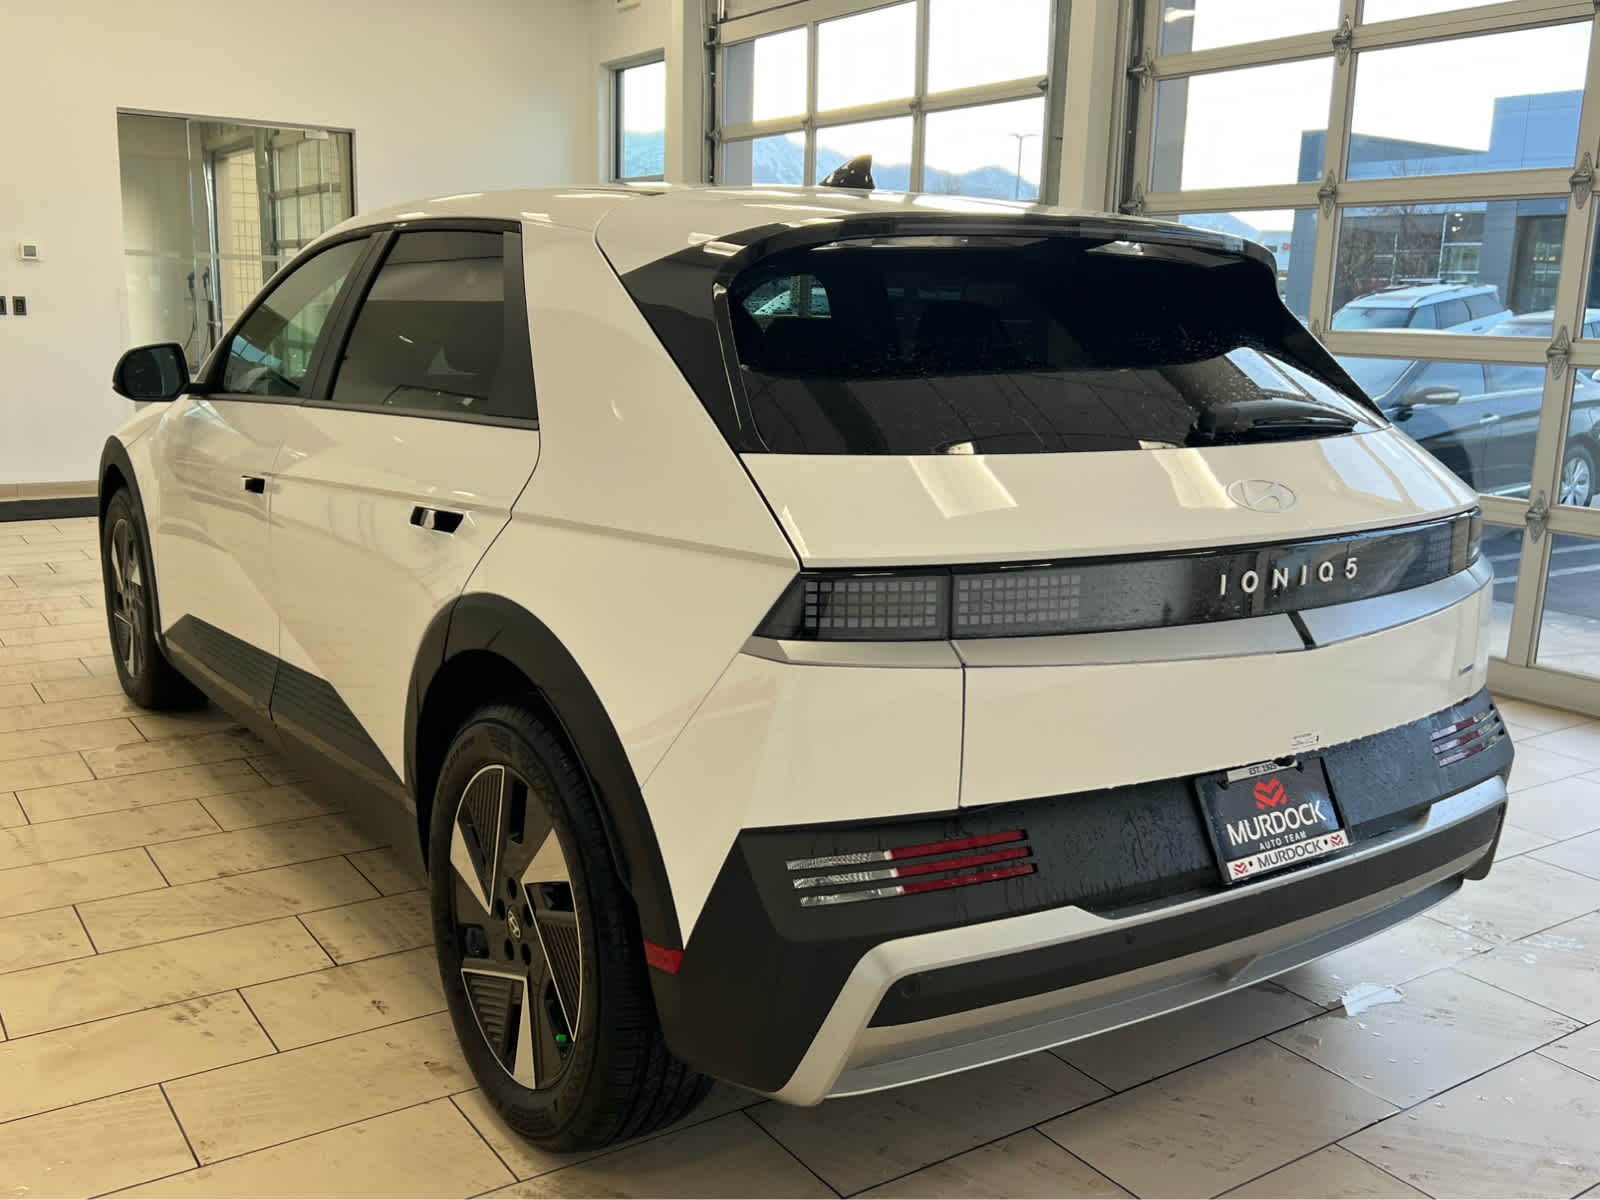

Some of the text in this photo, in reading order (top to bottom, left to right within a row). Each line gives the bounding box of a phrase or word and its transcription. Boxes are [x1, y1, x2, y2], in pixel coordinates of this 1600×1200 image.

[1226, 800, 1327, 846] MURDOCK
[1257, 839, 1323, 869] MURDOCK
[1259, 830, 1307, 851] AUTO TEAM
